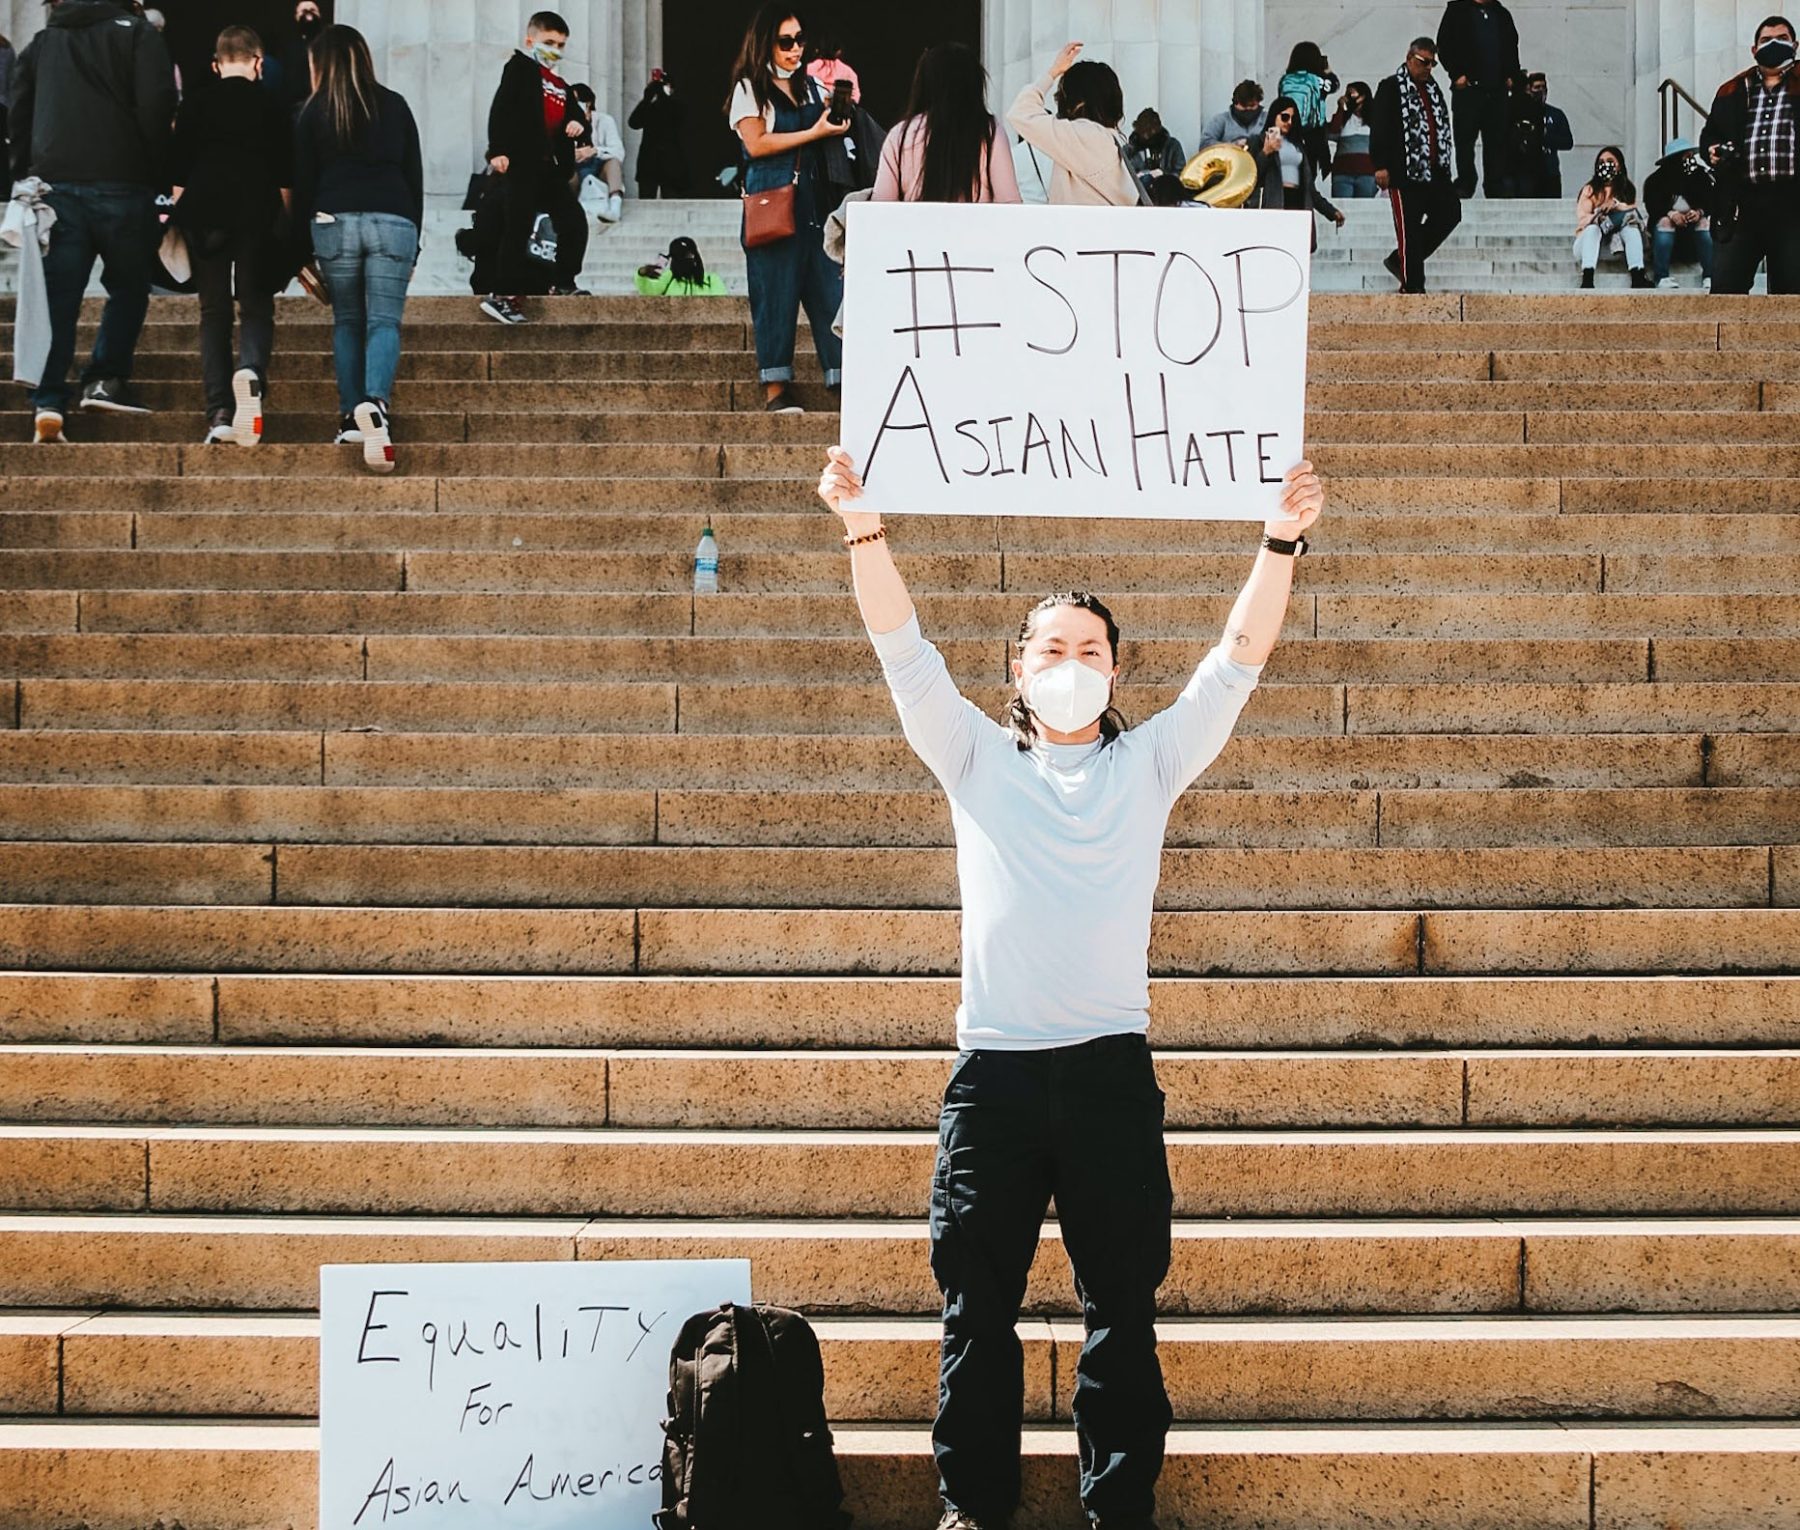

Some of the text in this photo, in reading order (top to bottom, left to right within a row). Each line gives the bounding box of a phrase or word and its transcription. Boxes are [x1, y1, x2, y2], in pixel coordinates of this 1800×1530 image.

[885, 246, 1303, 366] #STOP
[862, 366, 1283, 491] ASIAN HATE
[460, 1383, 513, 1432] For
[353, 1457, 471, 1525] Asian
